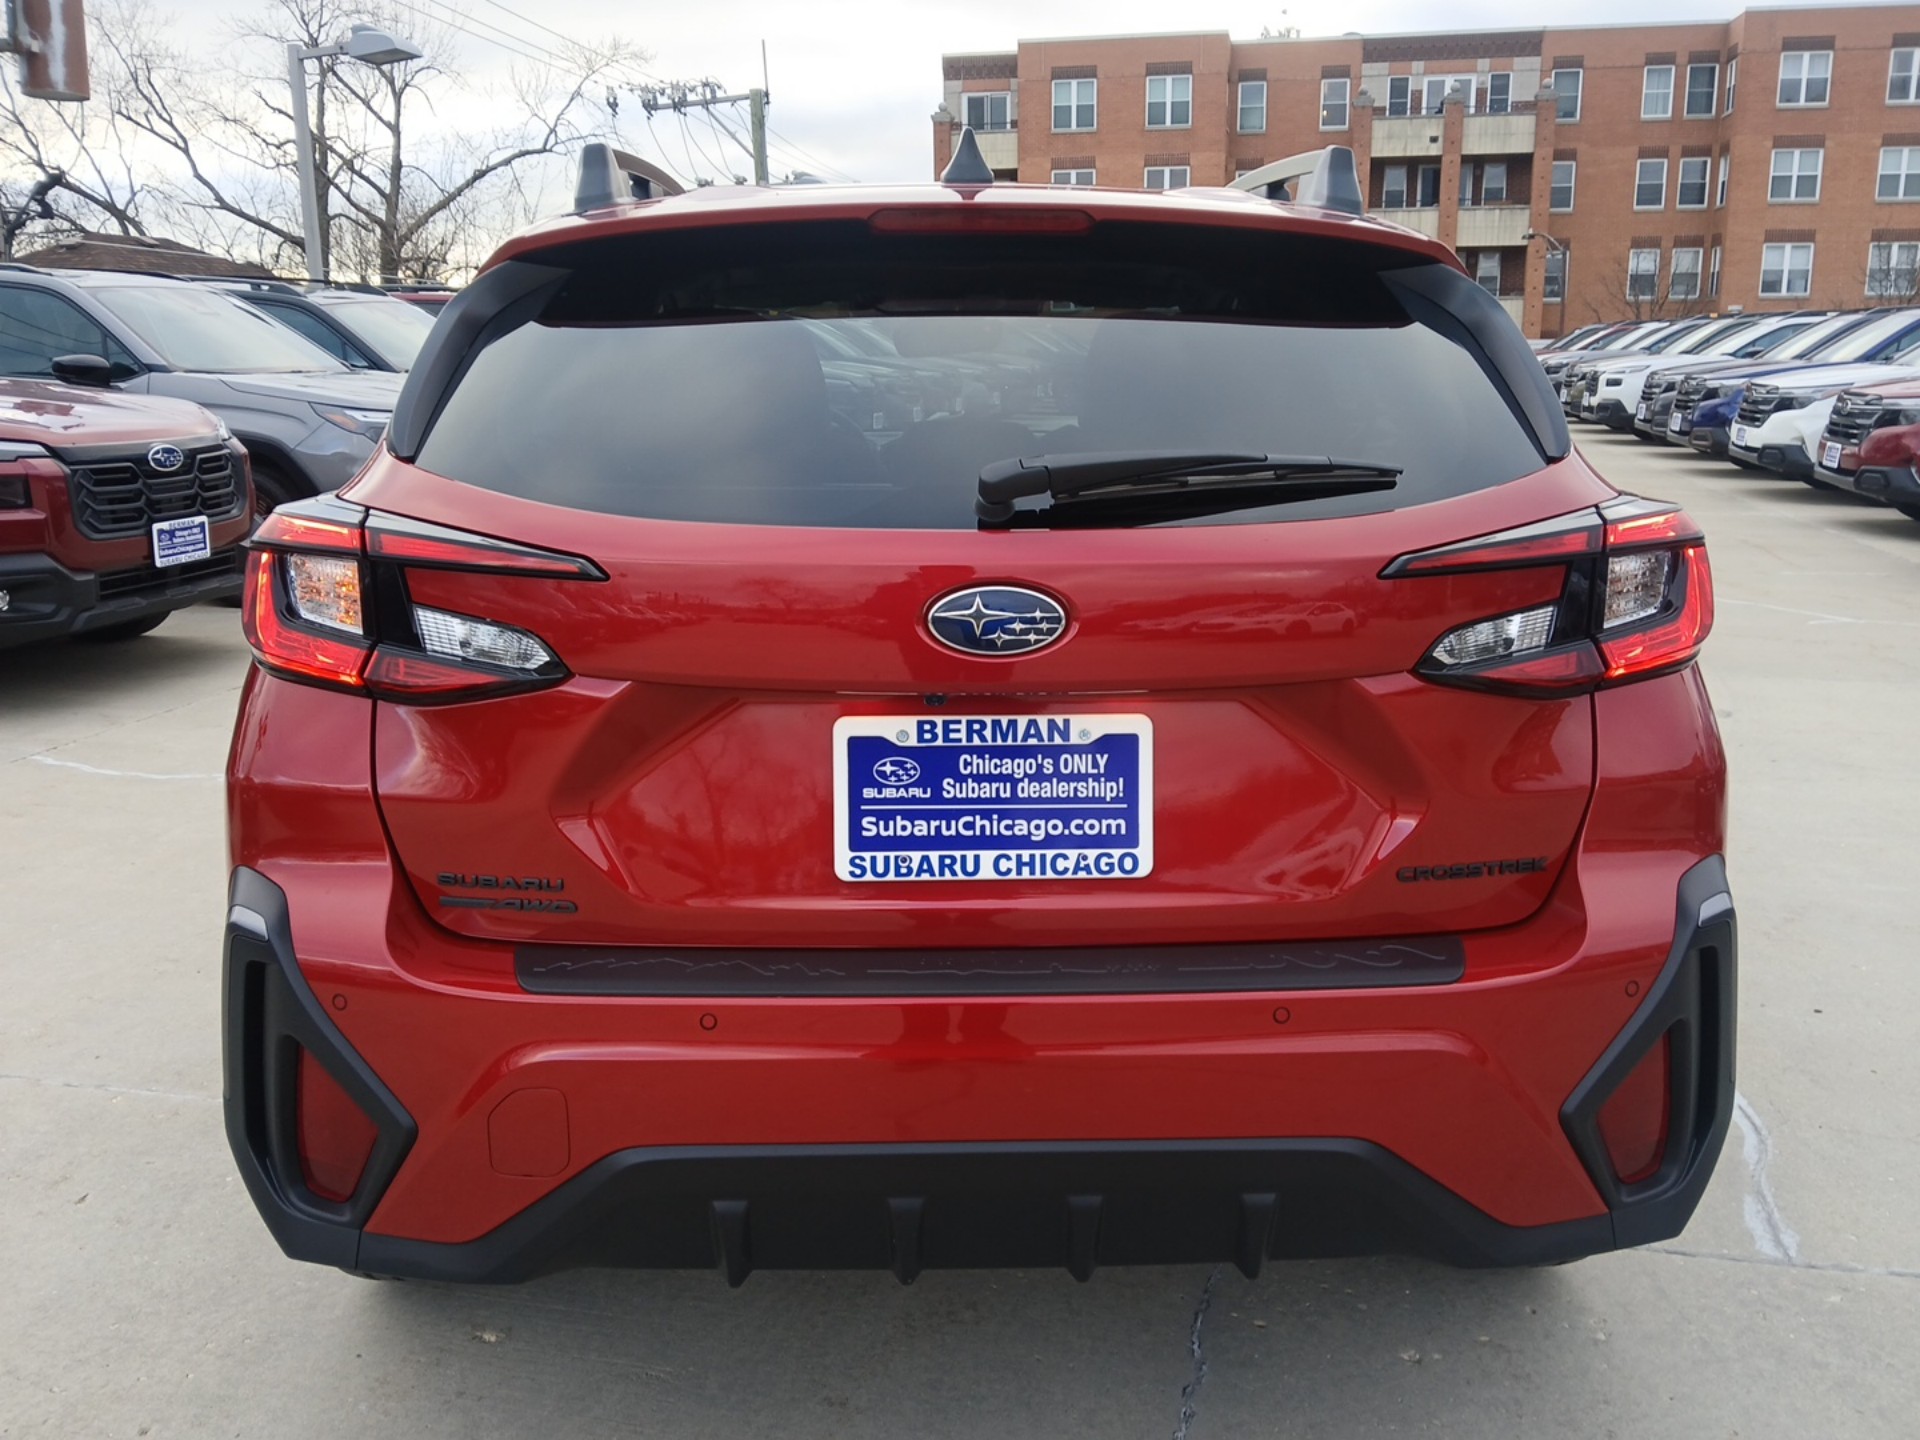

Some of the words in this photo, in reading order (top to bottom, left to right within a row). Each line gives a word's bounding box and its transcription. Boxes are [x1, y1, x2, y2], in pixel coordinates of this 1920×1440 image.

[916, 718, 1071, 744] BERMAN
[959, 753, 1054, 778] Chicago's
[1059, 753, 1109, 775] ONLY
[862, 787, 931, 799] SUBARU
[942, 778, 1012, 799] Subaru
[1017, 777, 1125, 802] dealership!
[861, 815, 1126, 841] SubaruChicago.com
[848, 854, 981, 879] SUBARU
[992, 852, 1140, 877] CHICAGO
[1396, 855, 1549, 883] CROSSTREK
[437, 872, 564, 892] SUBARU
[493, 898, 578, 913] AWD
